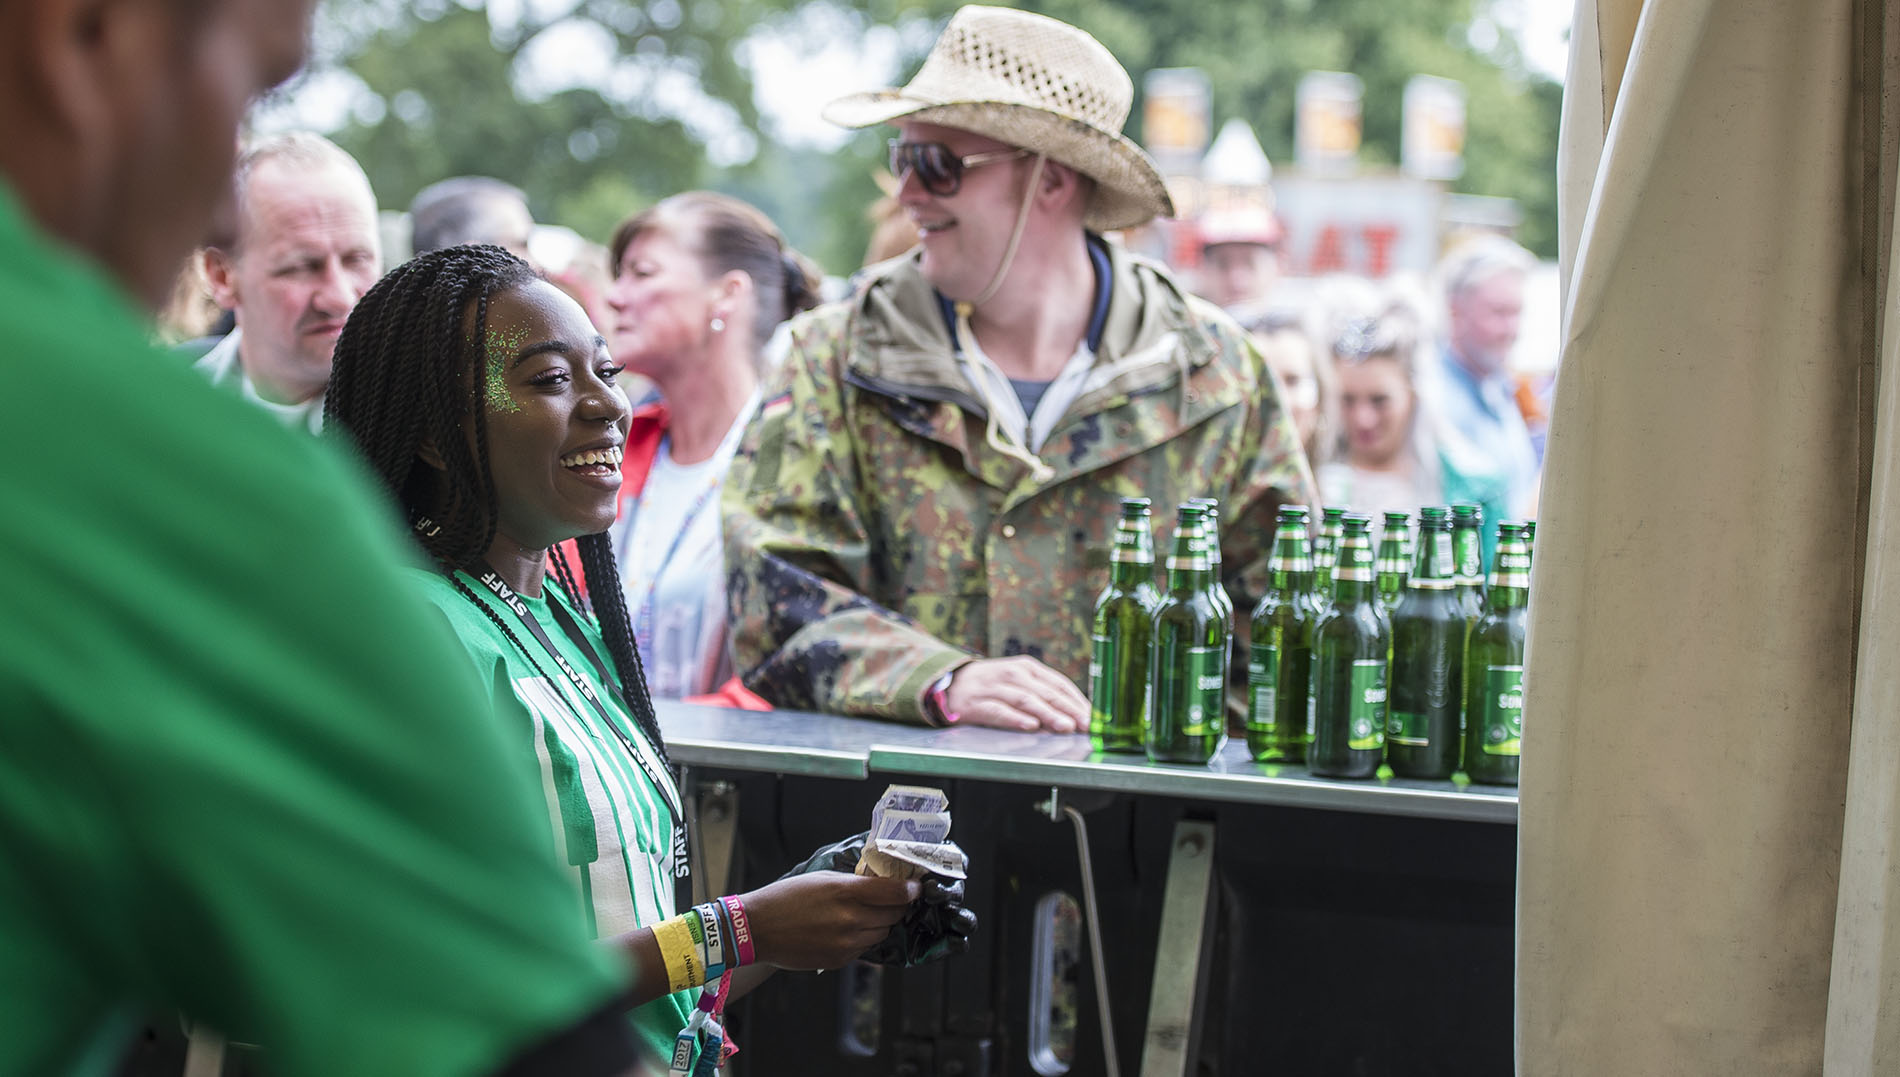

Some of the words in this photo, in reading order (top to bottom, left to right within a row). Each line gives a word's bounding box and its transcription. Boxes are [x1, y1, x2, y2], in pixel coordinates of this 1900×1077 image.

[480, 572, 528, 617] STAFF
[555, 653, 594, 701] STAFF
[622, 738, 659, 784] STAFF
[675, 825, 690, 878] STAFF
[702, 913, 719, 947] STAFF
[727, 898, 749, 945] TRADER
[675, 1041, 687, 1067] 2017
